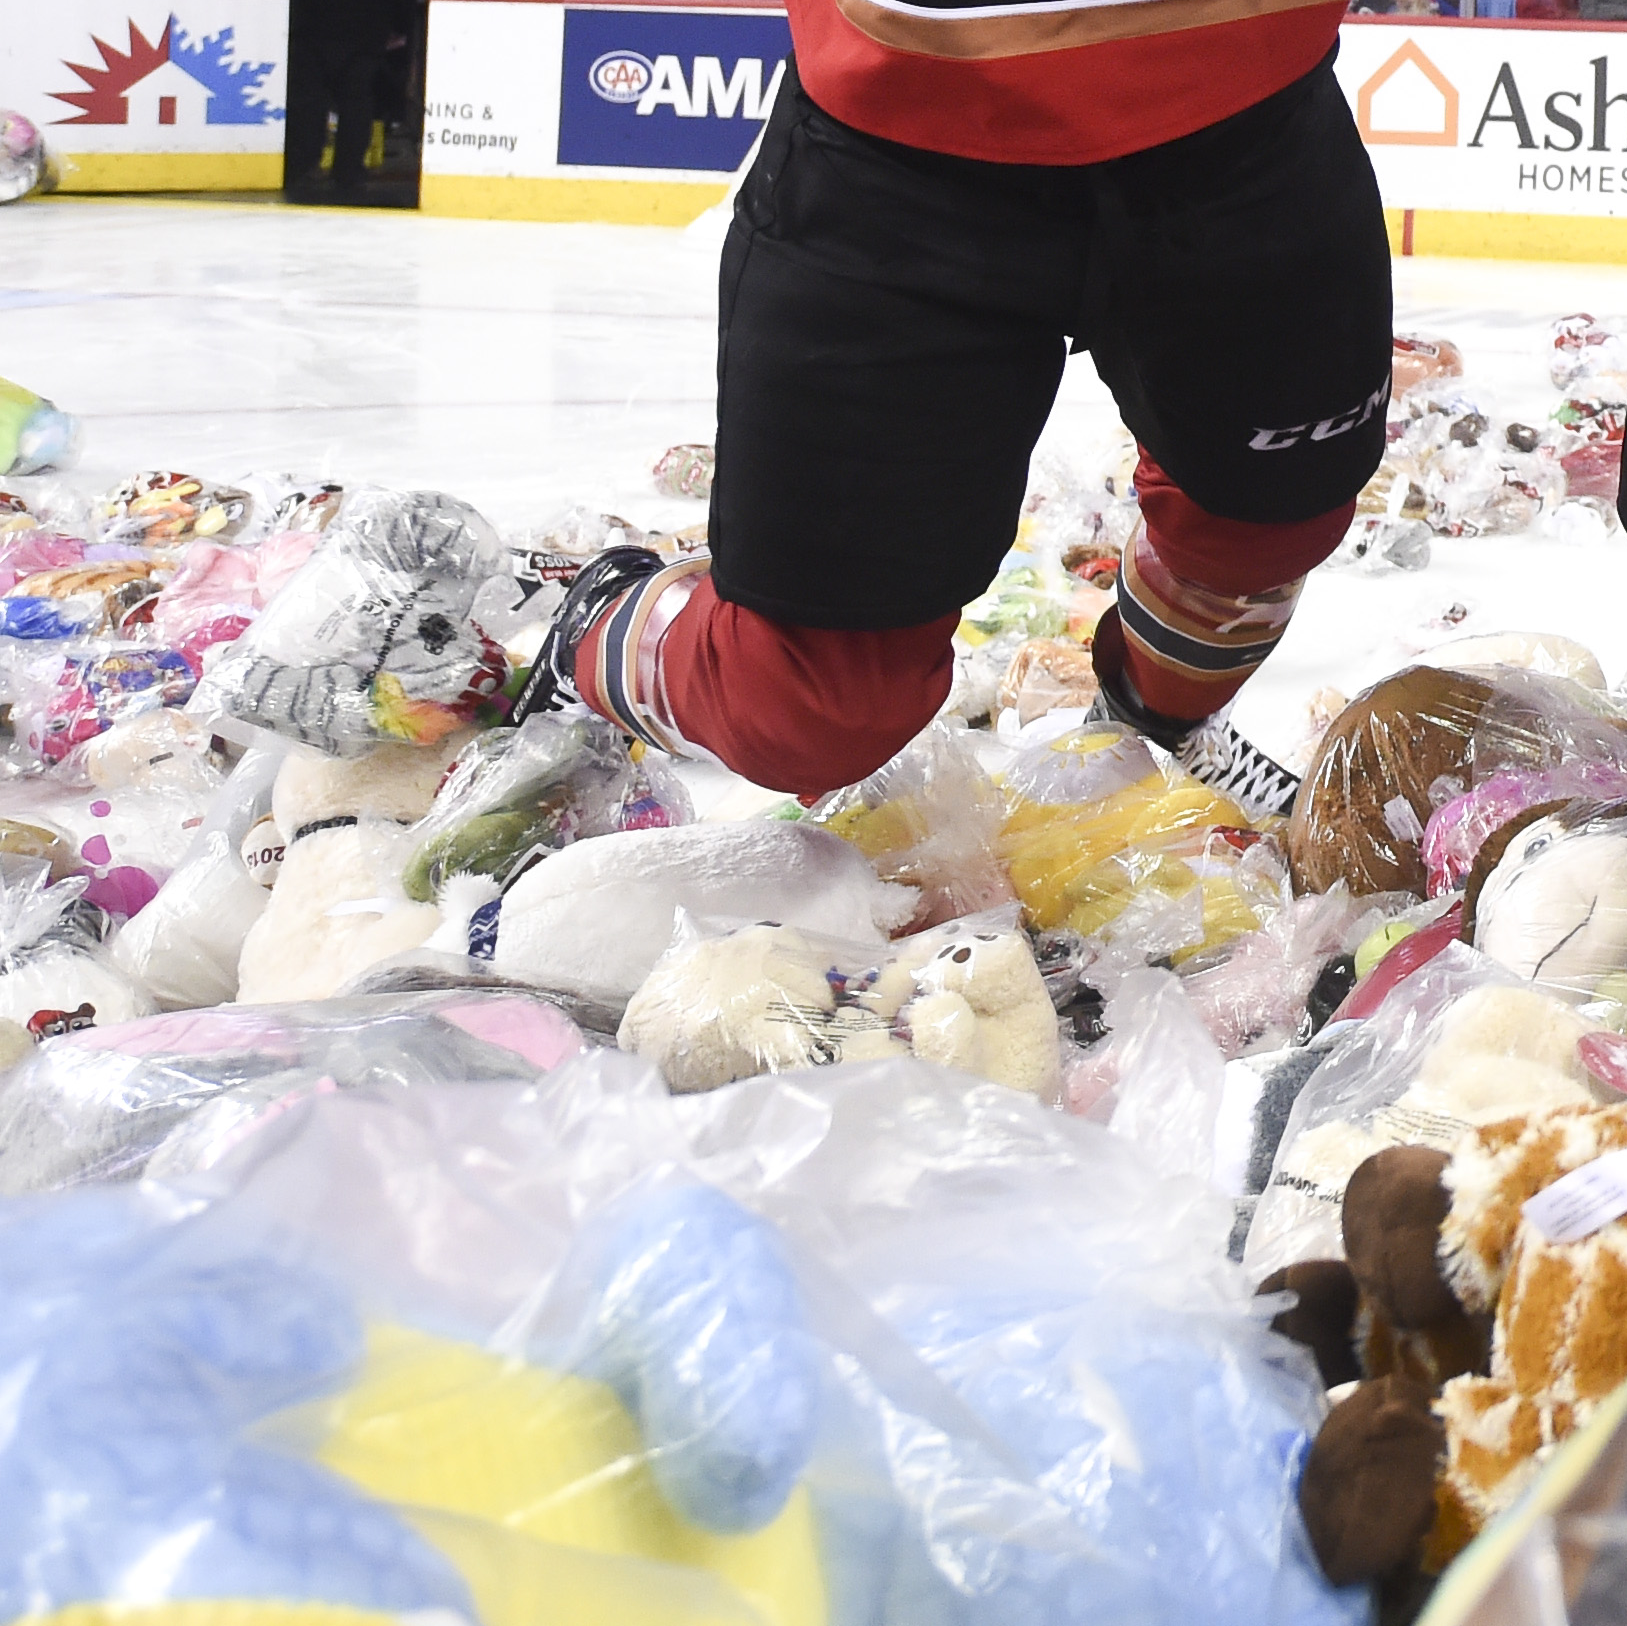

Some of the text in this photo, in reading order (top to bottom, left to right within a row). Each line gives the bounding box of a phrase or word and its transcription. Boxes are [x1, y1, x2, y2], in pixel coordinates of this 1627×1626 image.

[603, 61, 643, 90] CAA
[482, 105, 494, 120] &
[441, 129, 518, 152] Company
[1248, 371, 1390, 451] CCM
